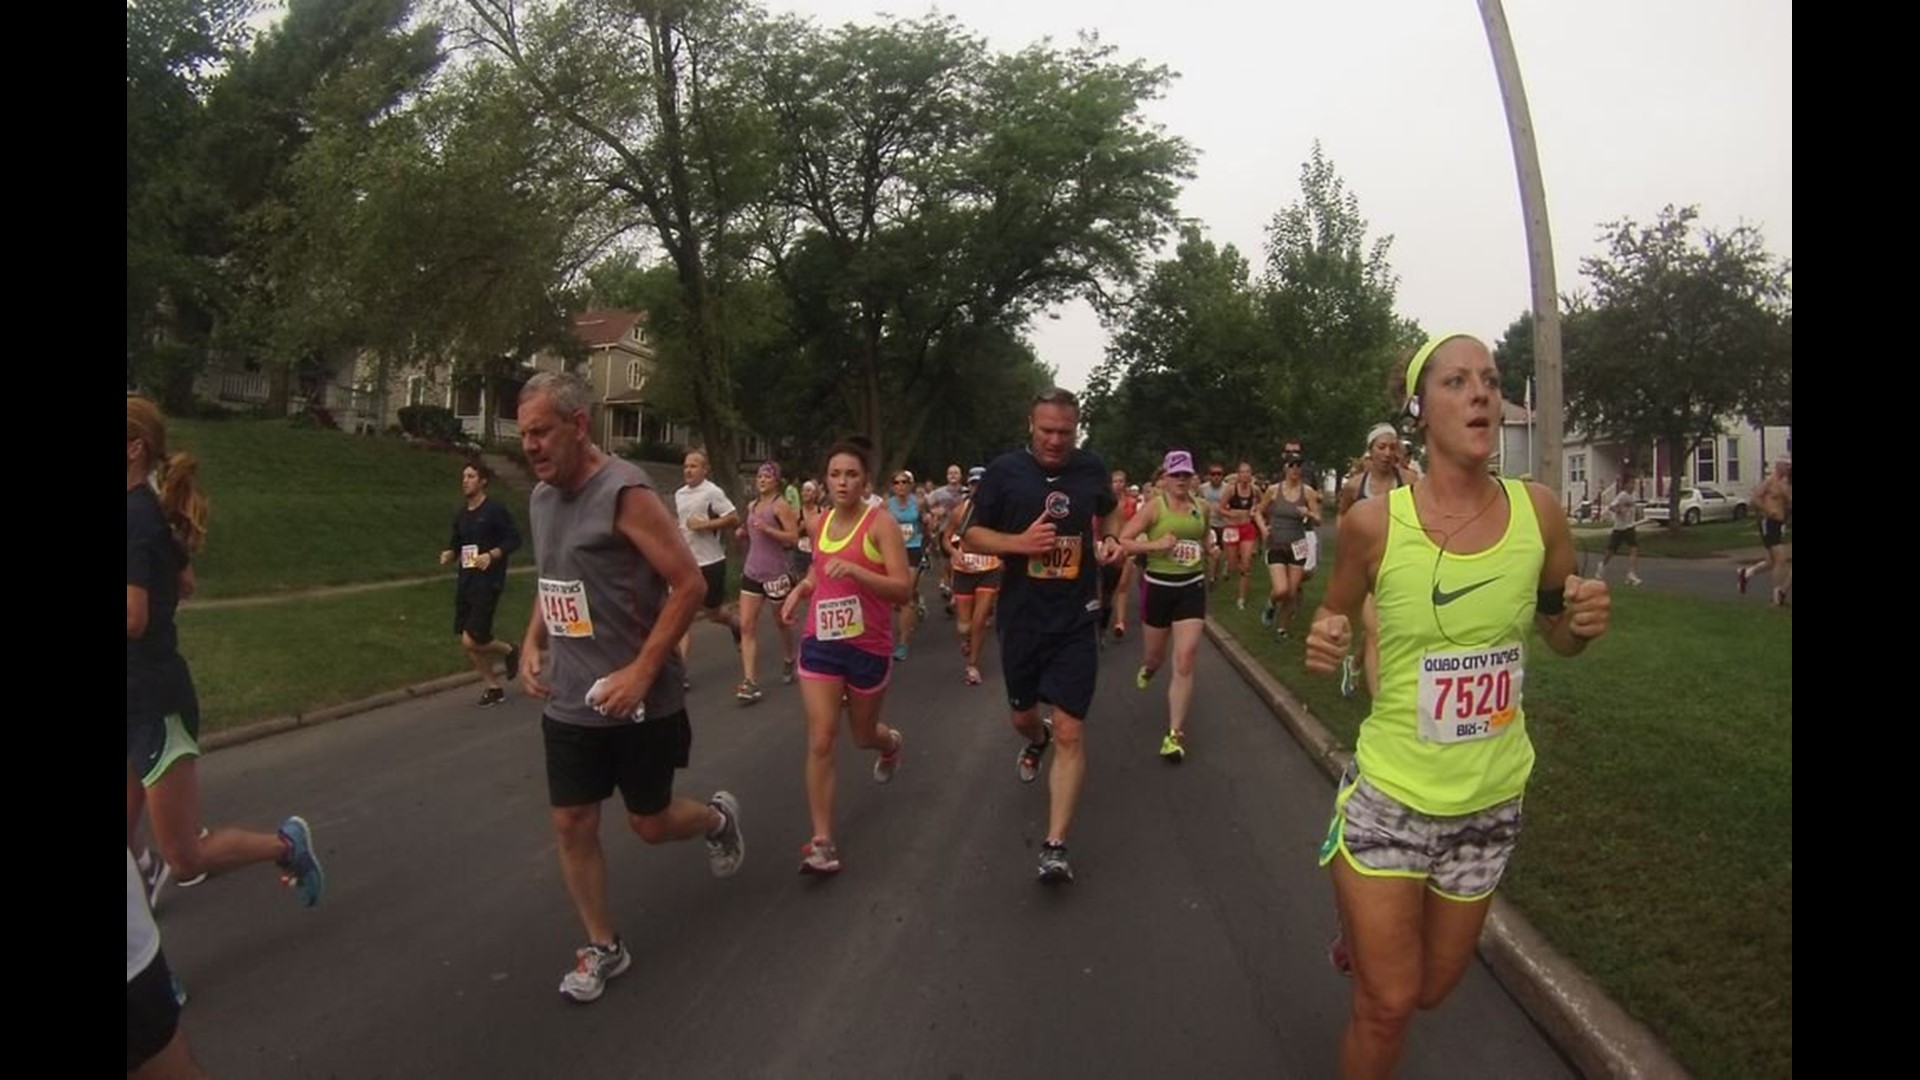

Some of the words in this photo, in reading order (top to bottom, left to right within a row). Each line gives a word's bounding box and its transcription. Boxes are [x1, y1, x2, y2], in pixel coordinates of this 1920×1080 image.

[544, 595, 579, 622] 1415
[820, 607, 856, 630] 9752
[1424, 657, 1460, 672] QUAD
[1462, 655, 1488, 670] CITY
[1490, 647, 1520, 666] TIMES
[1434, 669, 1511, 721] 7520
